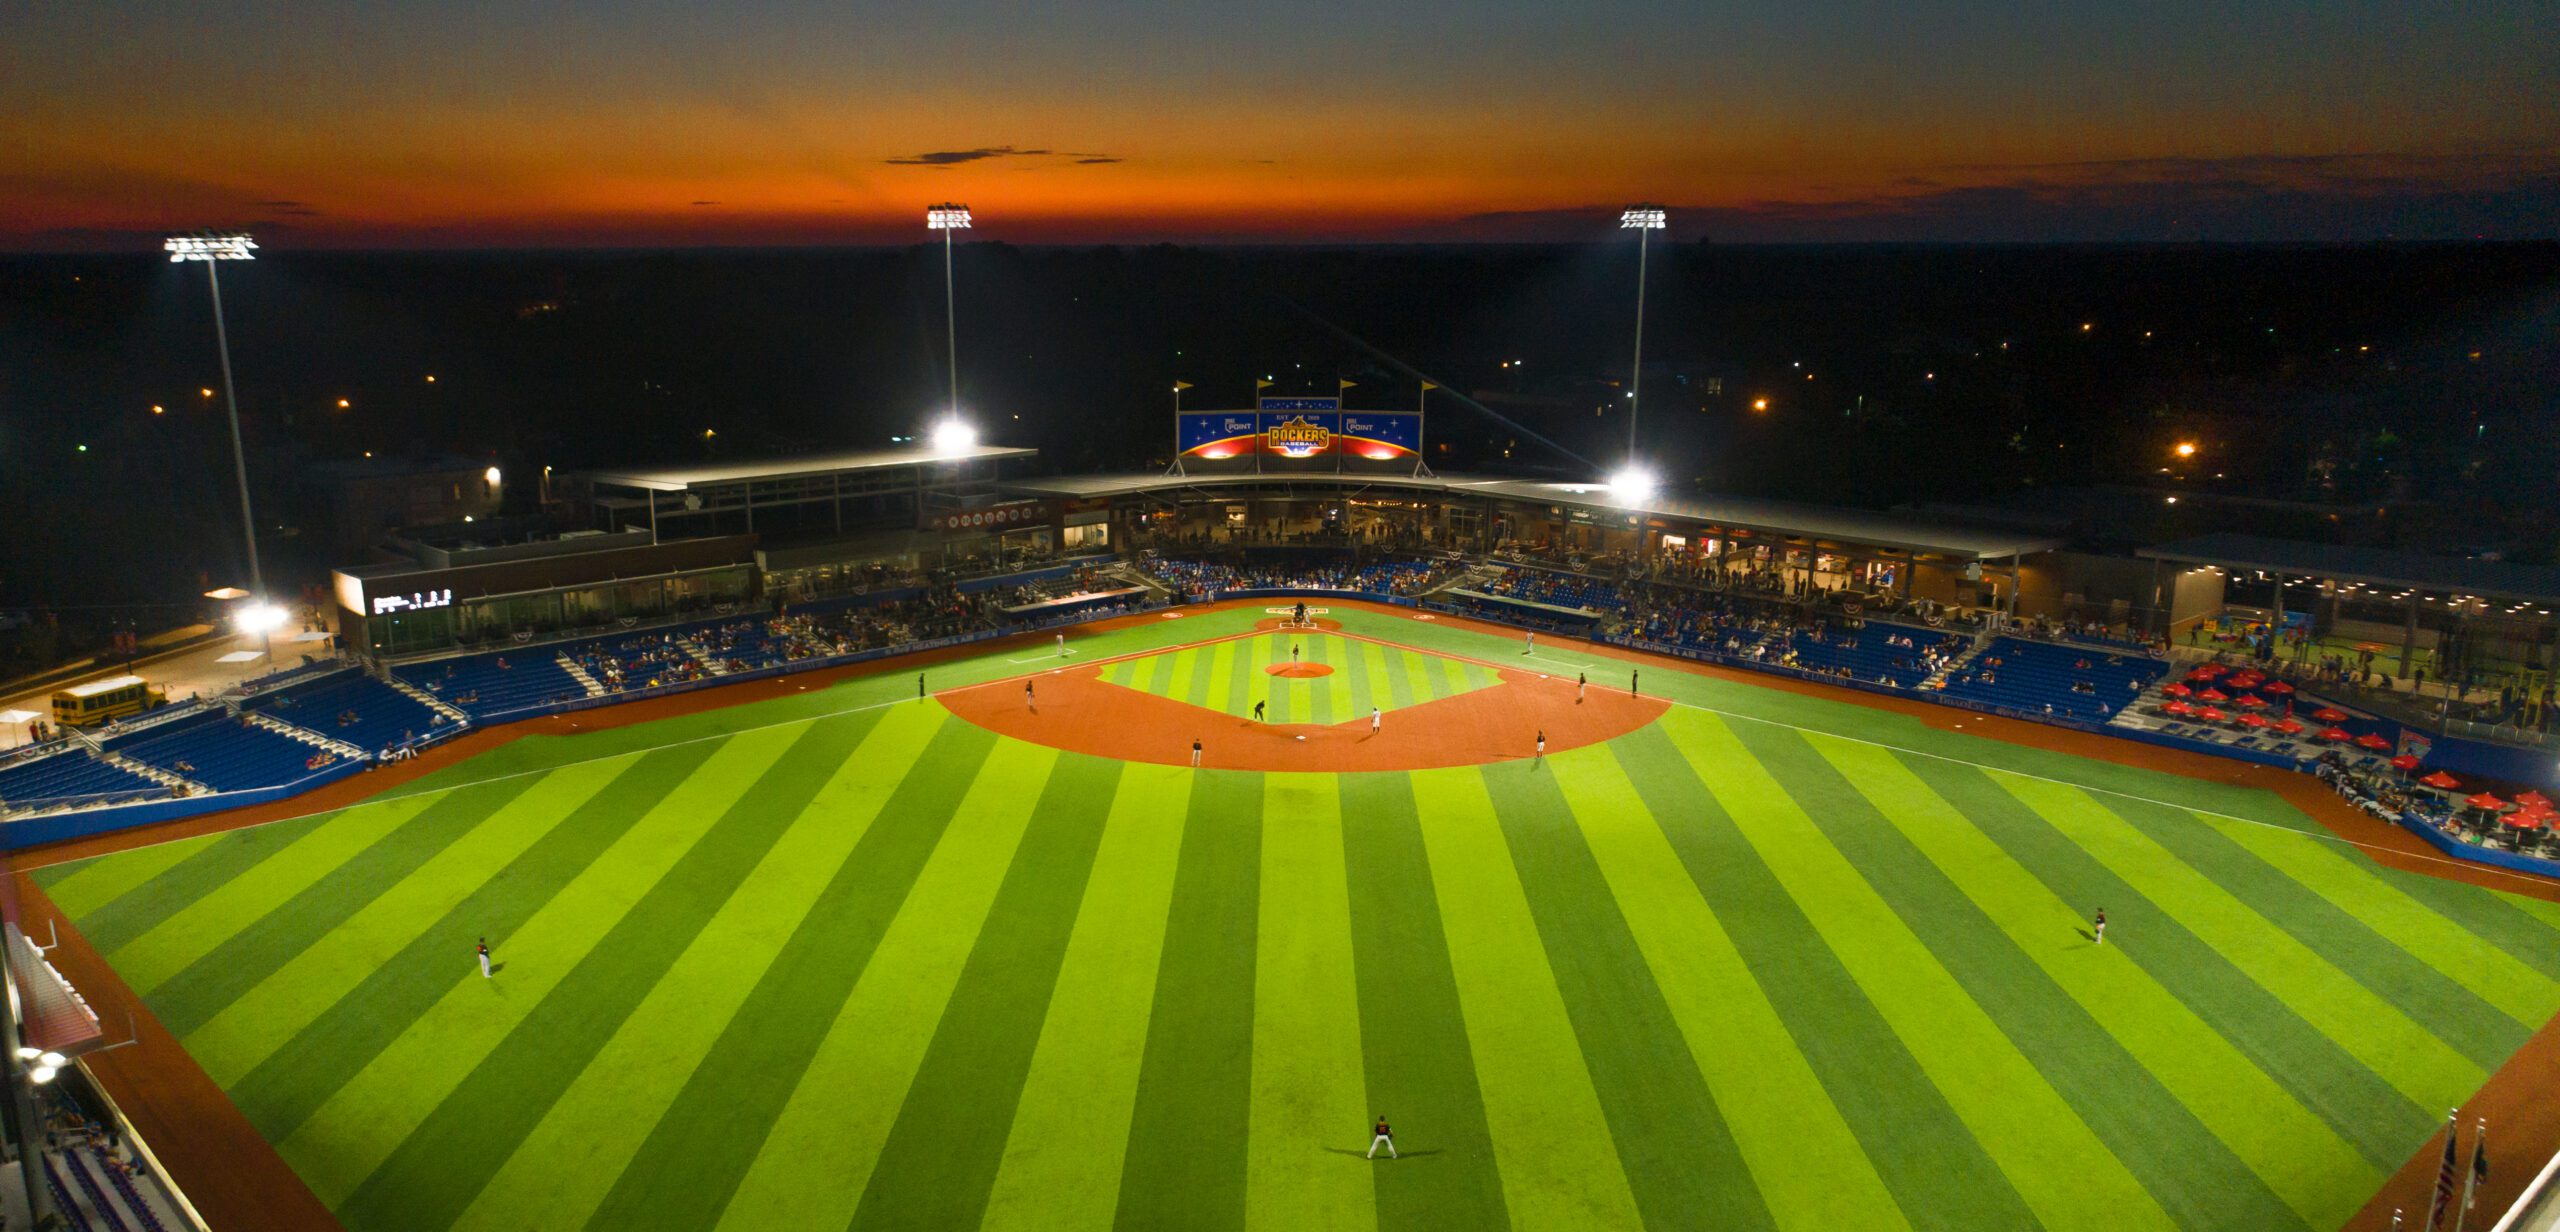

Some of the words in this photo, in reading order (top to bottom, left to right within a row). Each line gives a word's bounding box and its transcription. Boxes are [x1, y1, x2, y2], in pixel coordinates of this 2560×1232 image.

[1349, 423, 1374, 431] POINT
[1271, 428, 1328, 446] ROCKERS
[1632, 640, 1671, 654] HEATING
